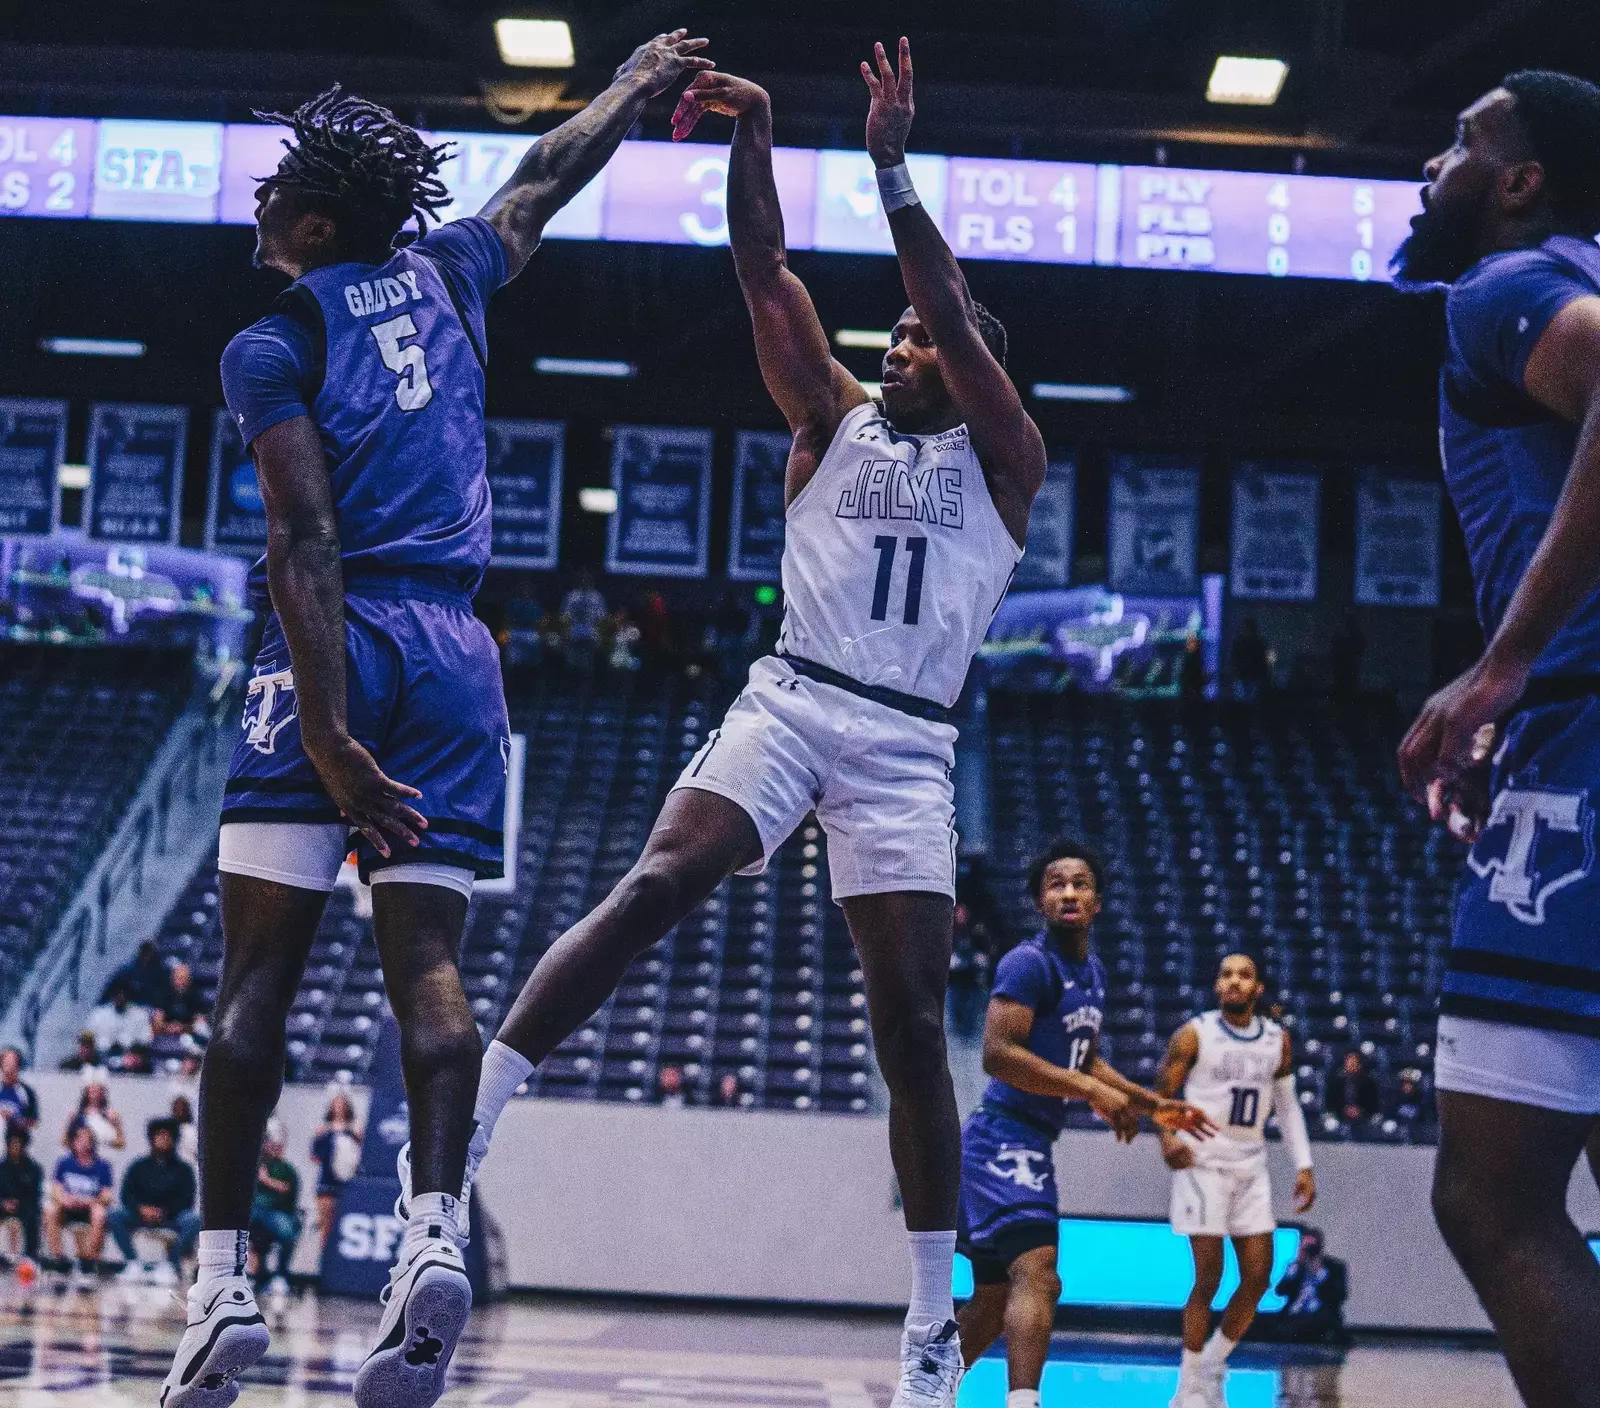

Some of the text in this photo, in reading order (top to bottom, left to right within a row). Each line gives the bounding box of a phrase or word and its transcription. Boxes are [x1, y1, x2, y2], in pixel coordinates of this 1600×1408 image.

[50, 128, 76, 167] 4
[46, 172, 75, 210] 2
[957, 168, 1078, 212] TOL 4
[1140, 174, 1211, 204] PLY
[1266, 179, 1290, 211] 4
[958, 213, 1076, 255] FLS 1
[1357, 217, 1373, 249] 1
[344, 270, 423, 317] GADDY
[370, 312, 434, 412] 5
[933, 440, 965, 453] WAC
[835, 459, 964, 530] JACKS
[850, 534, 928, 625] 11
[1488, 787, 1582, 903] T
[1229, 1086, 1260, 1127] 10
[338, 1212, 403, 1261] SF
